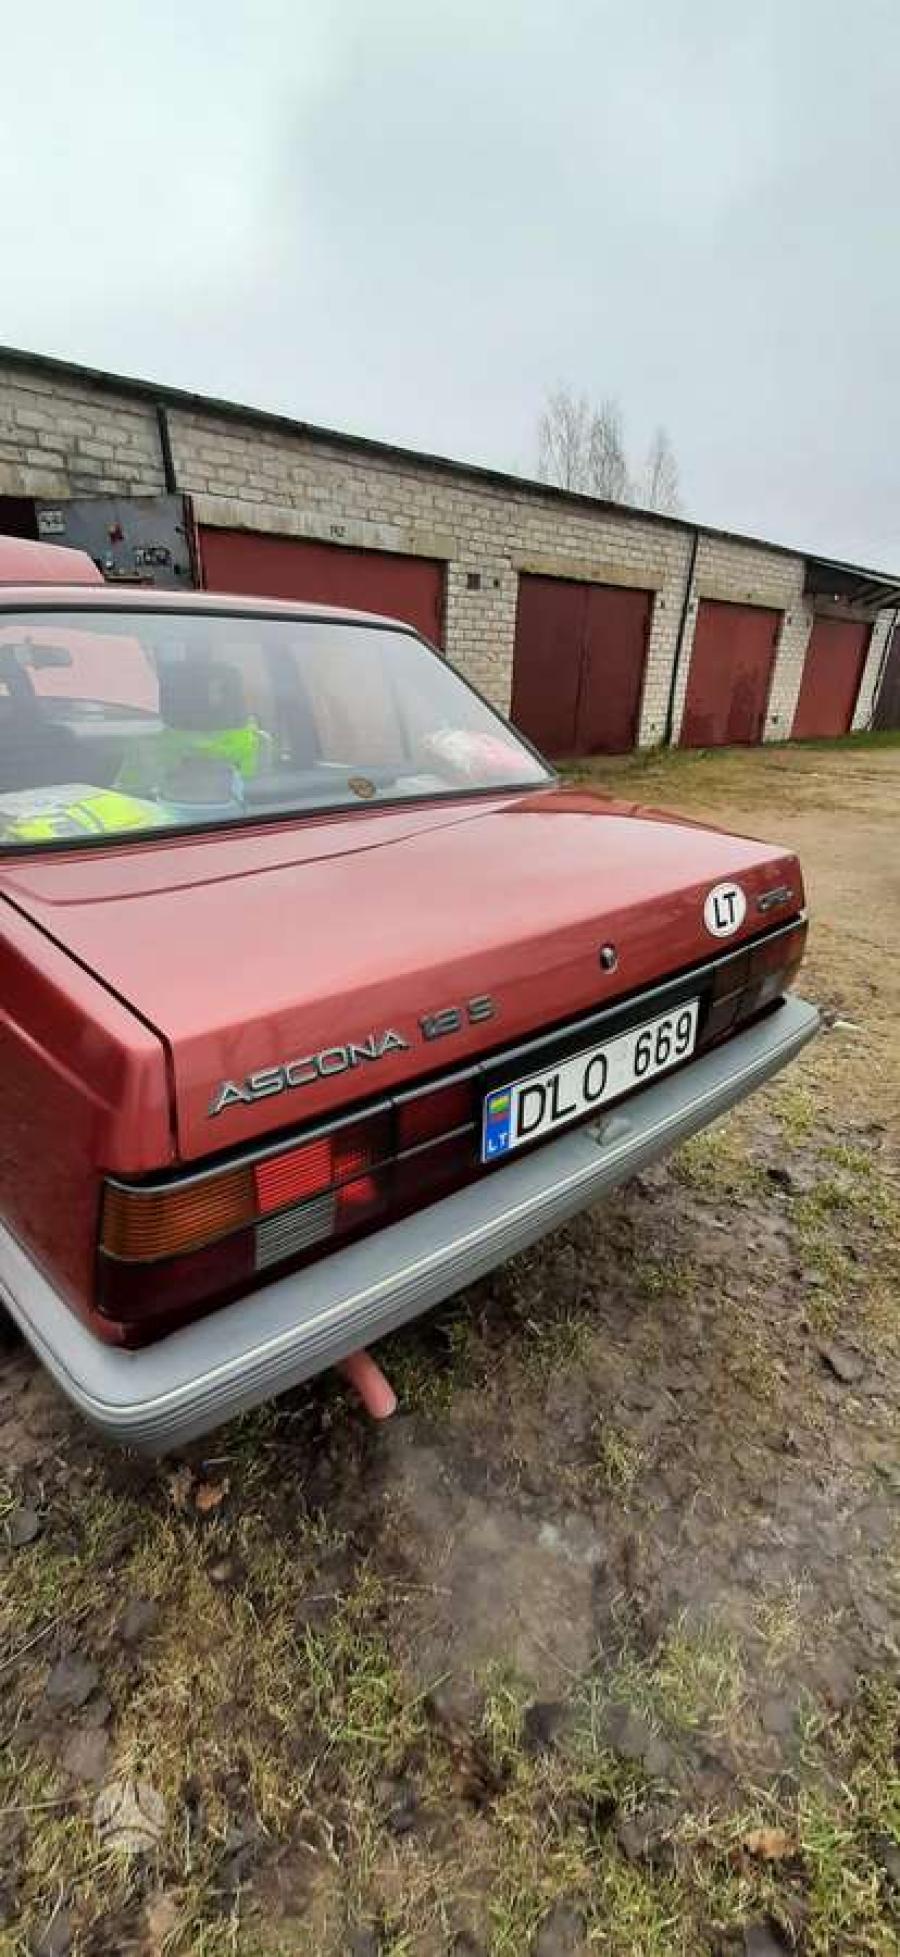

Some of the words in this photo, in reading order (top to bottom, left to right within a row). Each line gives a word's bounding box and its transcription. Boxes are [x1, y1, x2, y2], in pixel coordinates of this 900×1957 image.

[713, 891, 736, 928] LT
[208, 1028, 409, 1117] ASCONA
[468, 994, 496, 1024] S
[517, 1053, 608, 1138] DLO
[634, 1011, 692, 1076] 669
[488, 1132, 508, 1152] LT
